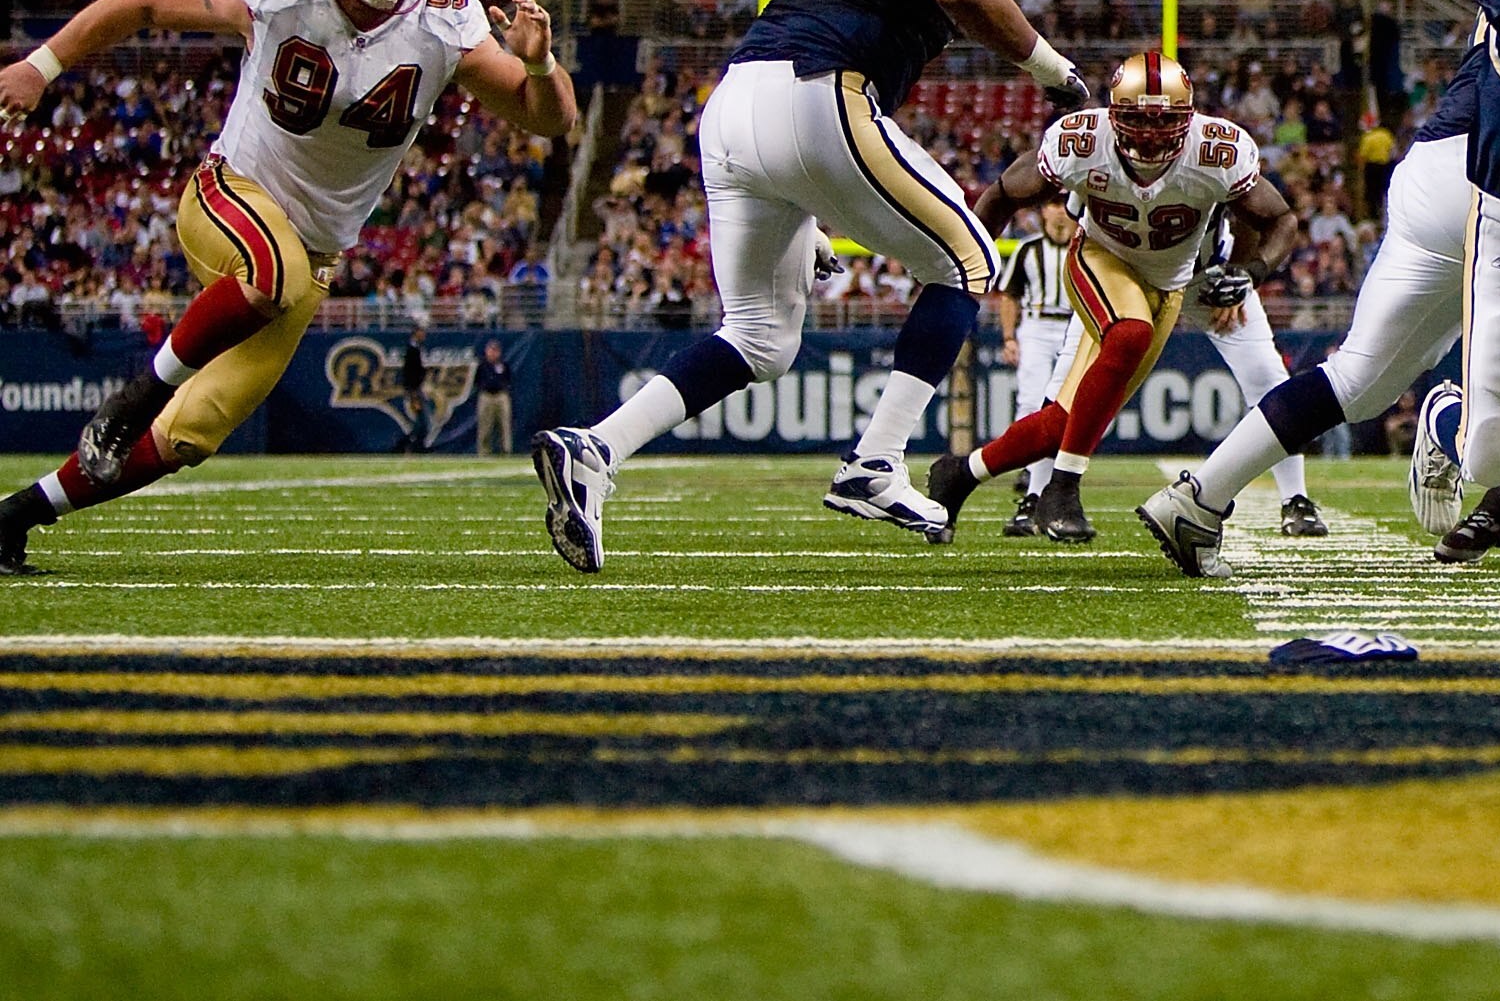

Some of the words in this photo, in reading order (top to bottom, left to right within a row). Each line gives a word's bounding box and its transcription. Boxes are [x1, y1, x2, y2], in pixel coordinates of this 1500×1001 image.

[262, 34, 424, 149] 94
[1058, 113, 1099, 159] 52
[1198, 121, 1241, 171] 52
[1087, 194, 1201, 251] 52
